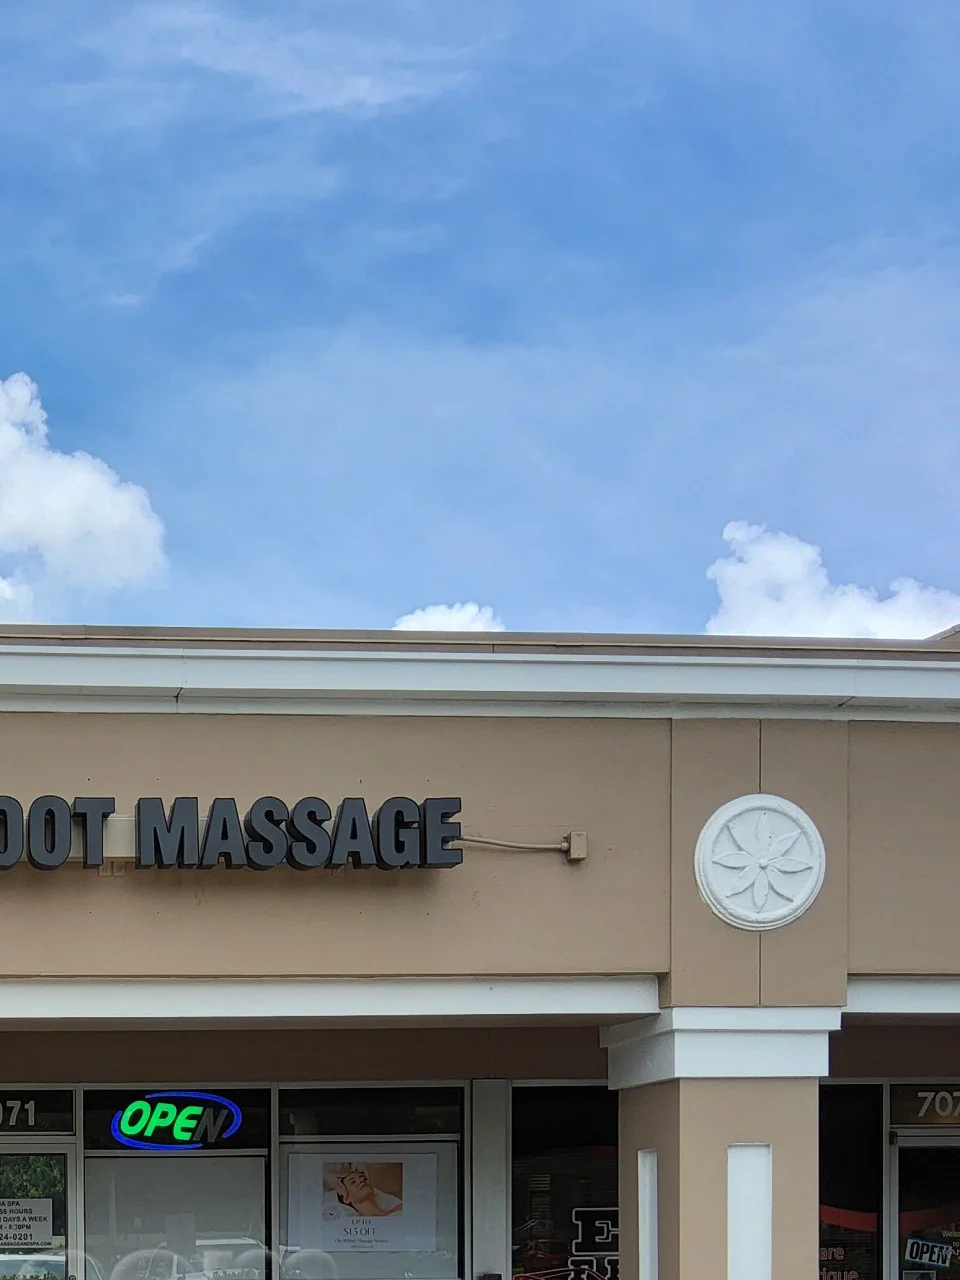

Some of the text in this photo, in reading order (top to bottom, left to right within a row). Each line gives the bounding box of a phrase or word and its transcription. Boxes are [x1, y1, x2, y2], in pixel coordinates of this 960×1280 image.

[134, 795, 464, 872] MASSAGE
[120, 1098, 230, 1142] OPEN
[909, 1241, 950, 1264] OPEN
